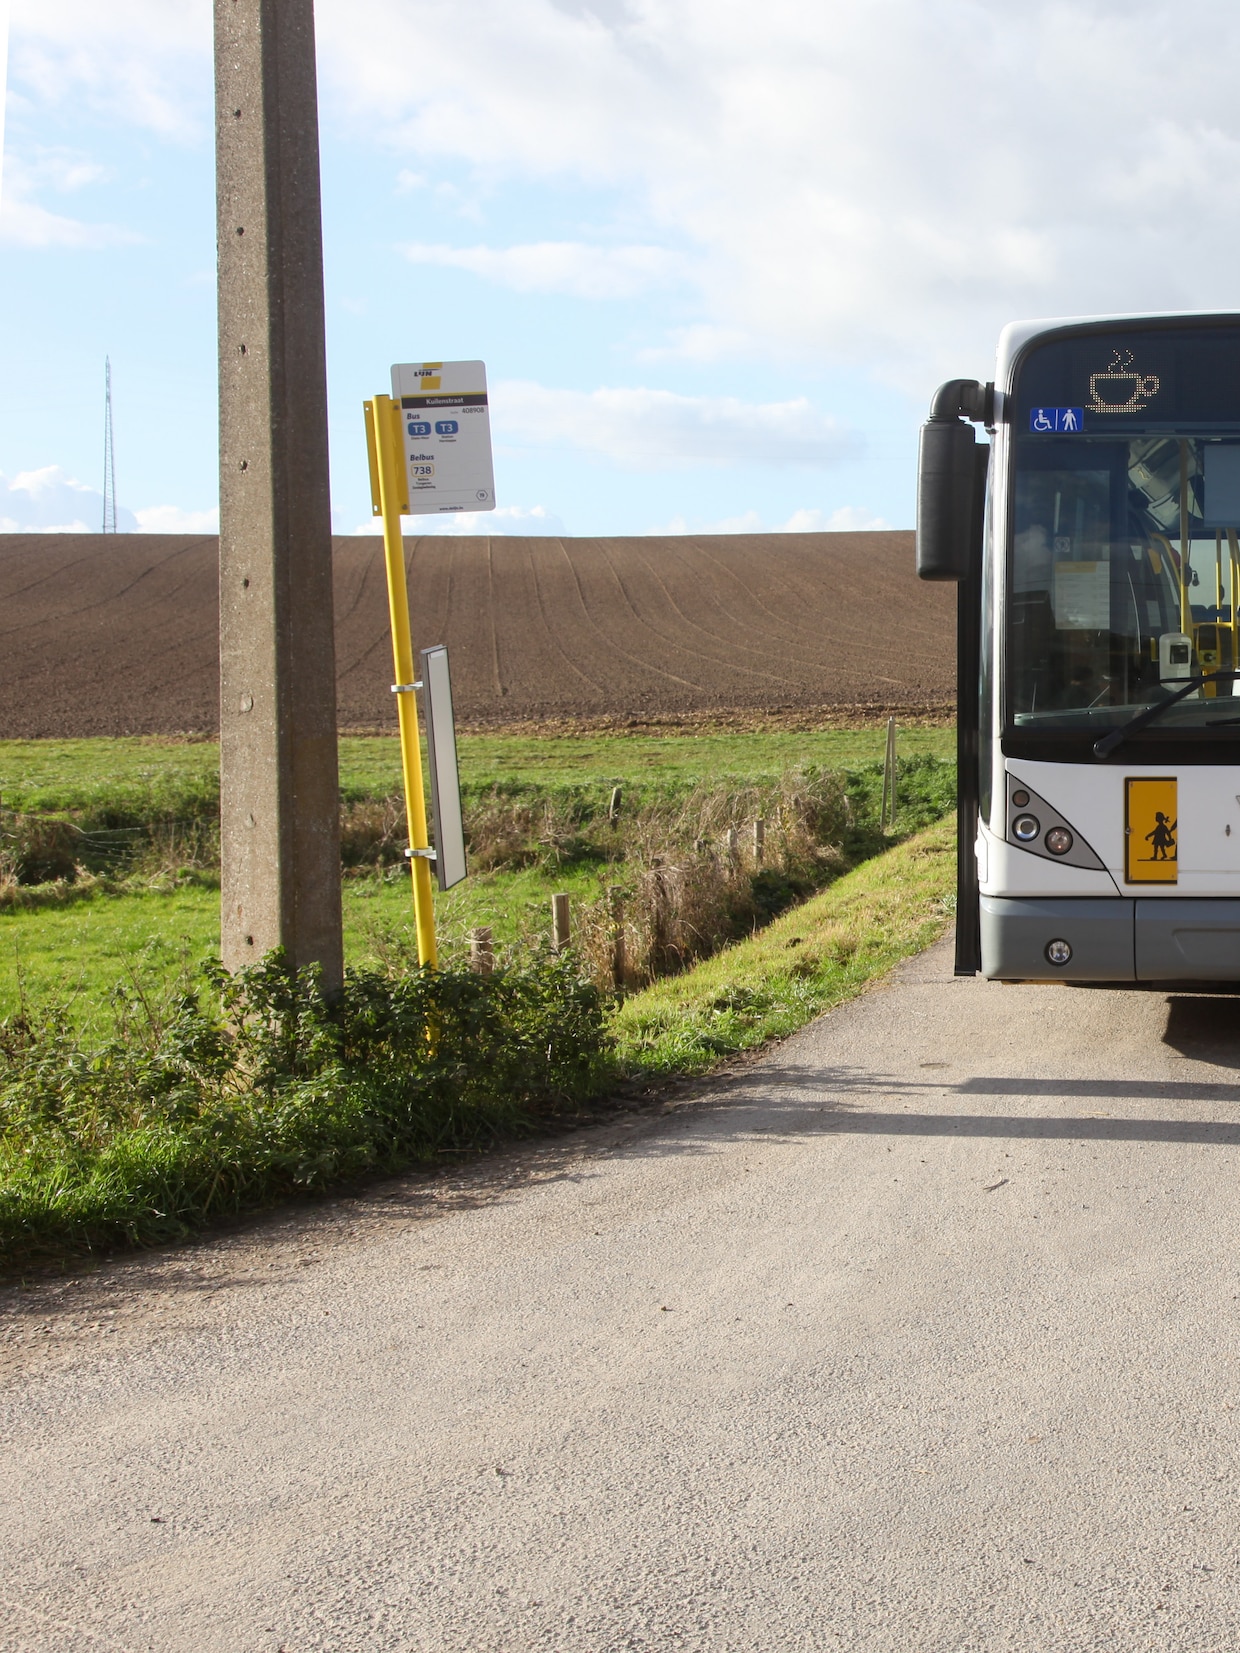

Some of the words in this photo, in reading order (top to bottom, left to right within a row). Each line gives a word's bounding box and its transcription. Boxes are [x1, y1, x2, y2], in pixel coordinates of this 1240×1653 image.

[462, 406, 484, 414] 408908
[412, 424, 426, 433] T3
[440, 423, 453, 432] T3
[414, 466, 432, 475] 738
